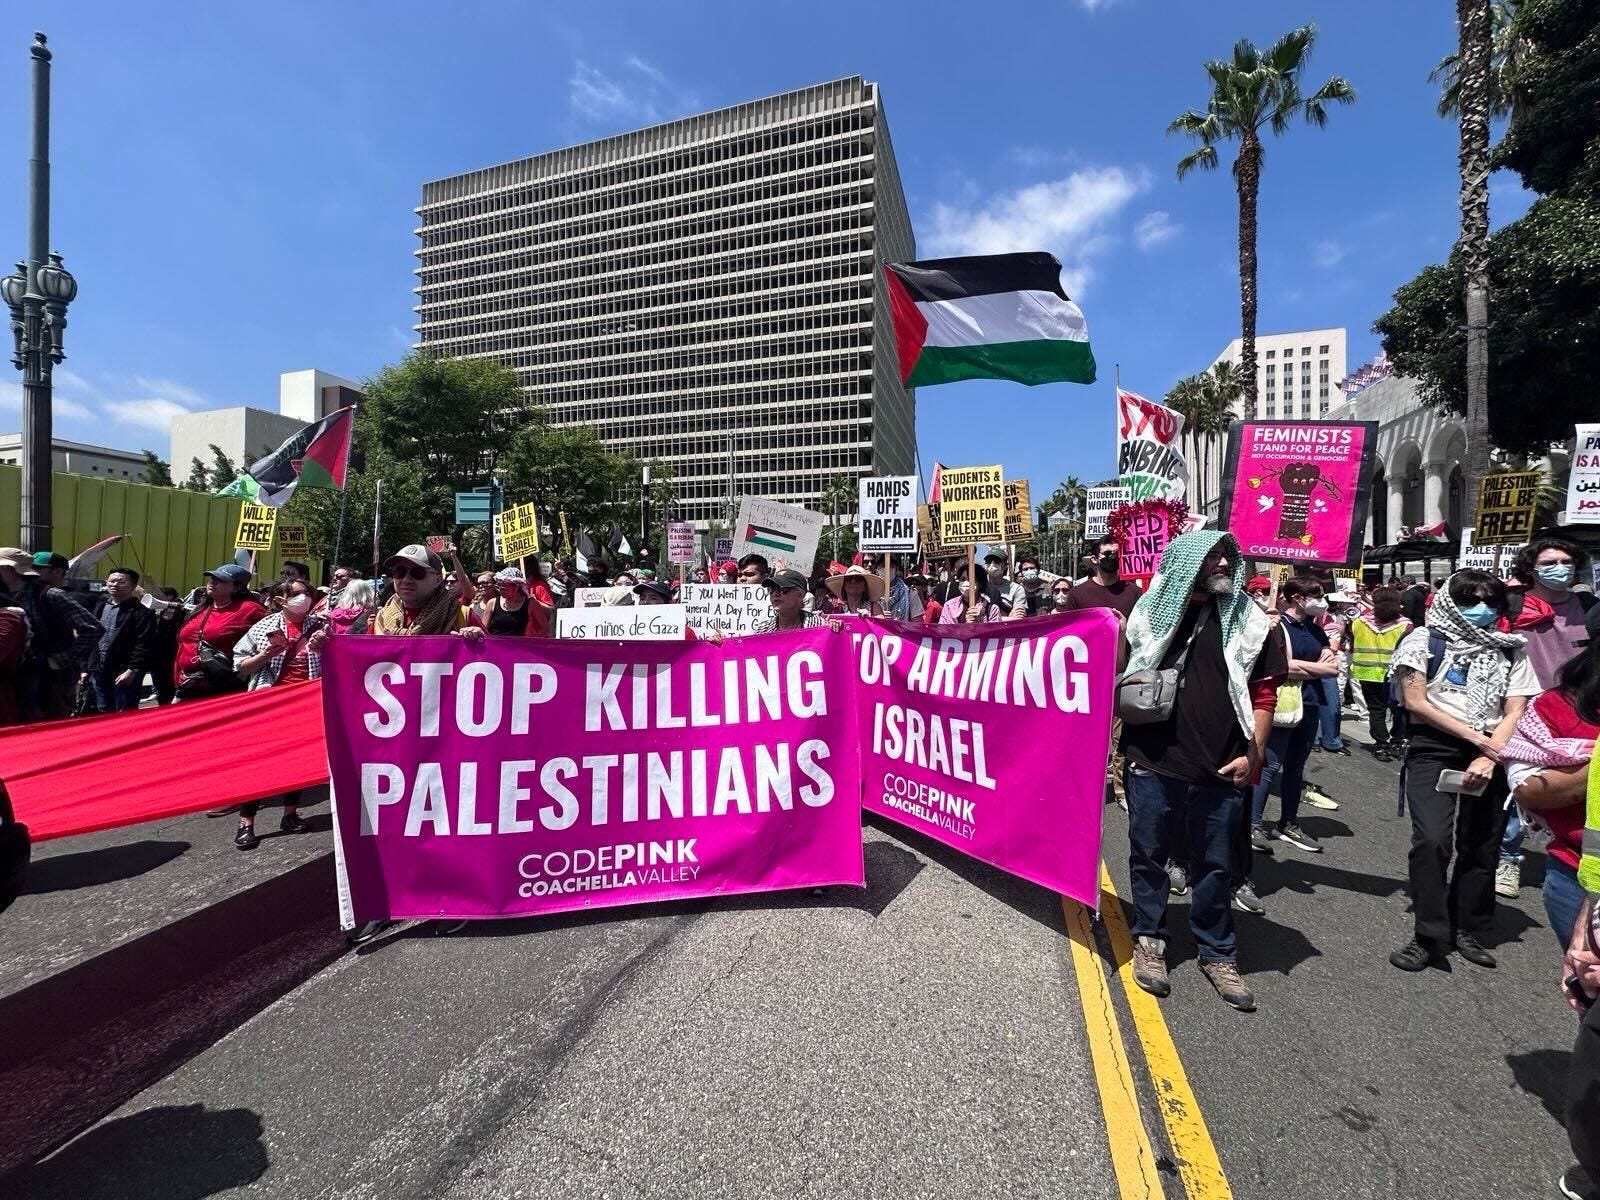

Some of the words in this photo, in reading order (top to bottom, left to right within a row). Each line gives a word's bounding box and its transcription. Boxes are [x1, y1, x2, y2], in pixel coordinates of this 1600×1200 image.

[1253, 427, 1353, 444] FEMINISTS
[1252, 443, 1288, 453] STAND
[1289, 444, 1312, 454] FOR
[1315, 445, 1351, 455] PEACE
[1265, 453, 1306, 461] OCCUPATION
[1576, 454, 1588, 468] IS
[942, 471, 991, 486] STUDENTS
[993, 471, 1000, 481] &
[1485, 475, 1537, 491] PALESTINE
[867, 481, 910, 497] HANDS
[942, 484, 1001, 503] WORKERS
[1089, 490, 1122, 499] STUDENTS
[877, 498, 899, 514] OFF
[1484, 492, 1511, 509] WILL
[1517, 489, 1535, 506] BE
[243, 505, 264, 520] WILL
[266, 507, 275, 520] BE
[502, 510, 516, 524] END
[518, 505, 532, 518] ALL
[944, 509, 977, 522] UNITED
[979, 507, 998, 520] FOR
[239, 522, 273, 543] FREE!
[503, 521, 518, 535] U.S.
[519, 516, 533, 530] AID
[863, 518, 913, 538] RAFAH
[945, 521, 1000, 536] PALESTINE
[1121, 514, 1163, 537] RED
[1479, 510, 1531, 537] FREE!
[506, 535, 534, 554] ISRAEL!
[1122, 534, 1164, 556] LINE
[1249, 545, 1320, 559] CODEPINK
[1122, 555, 1155, 574] NOW
[741, 586, 752, 601] To
[713, 603, 722, 615] A
[725, 603, 743, 624] Day
[746, 603, 763, 617] For
[559, 620, 586, 639] Los
[595, 621, 625, 638] niños
[629, 614, 646, 636] de
[649, 615, 679, 635] Gaza
[705, 617, 732, 630] Killed
[736, 618, 746, 631] In
[907, 635, 1090, 714] ARMING
[363, 661, 558, 738] STOP
[584, 650, 828, 732] KILLING
[872, 702, 997, 791] ISRAEL
[360, 739, 835, 838] PALESTINIANS
[884, 772, 977, 825] CODEPINK
[518, 838, 698, 879] CODEPINK
